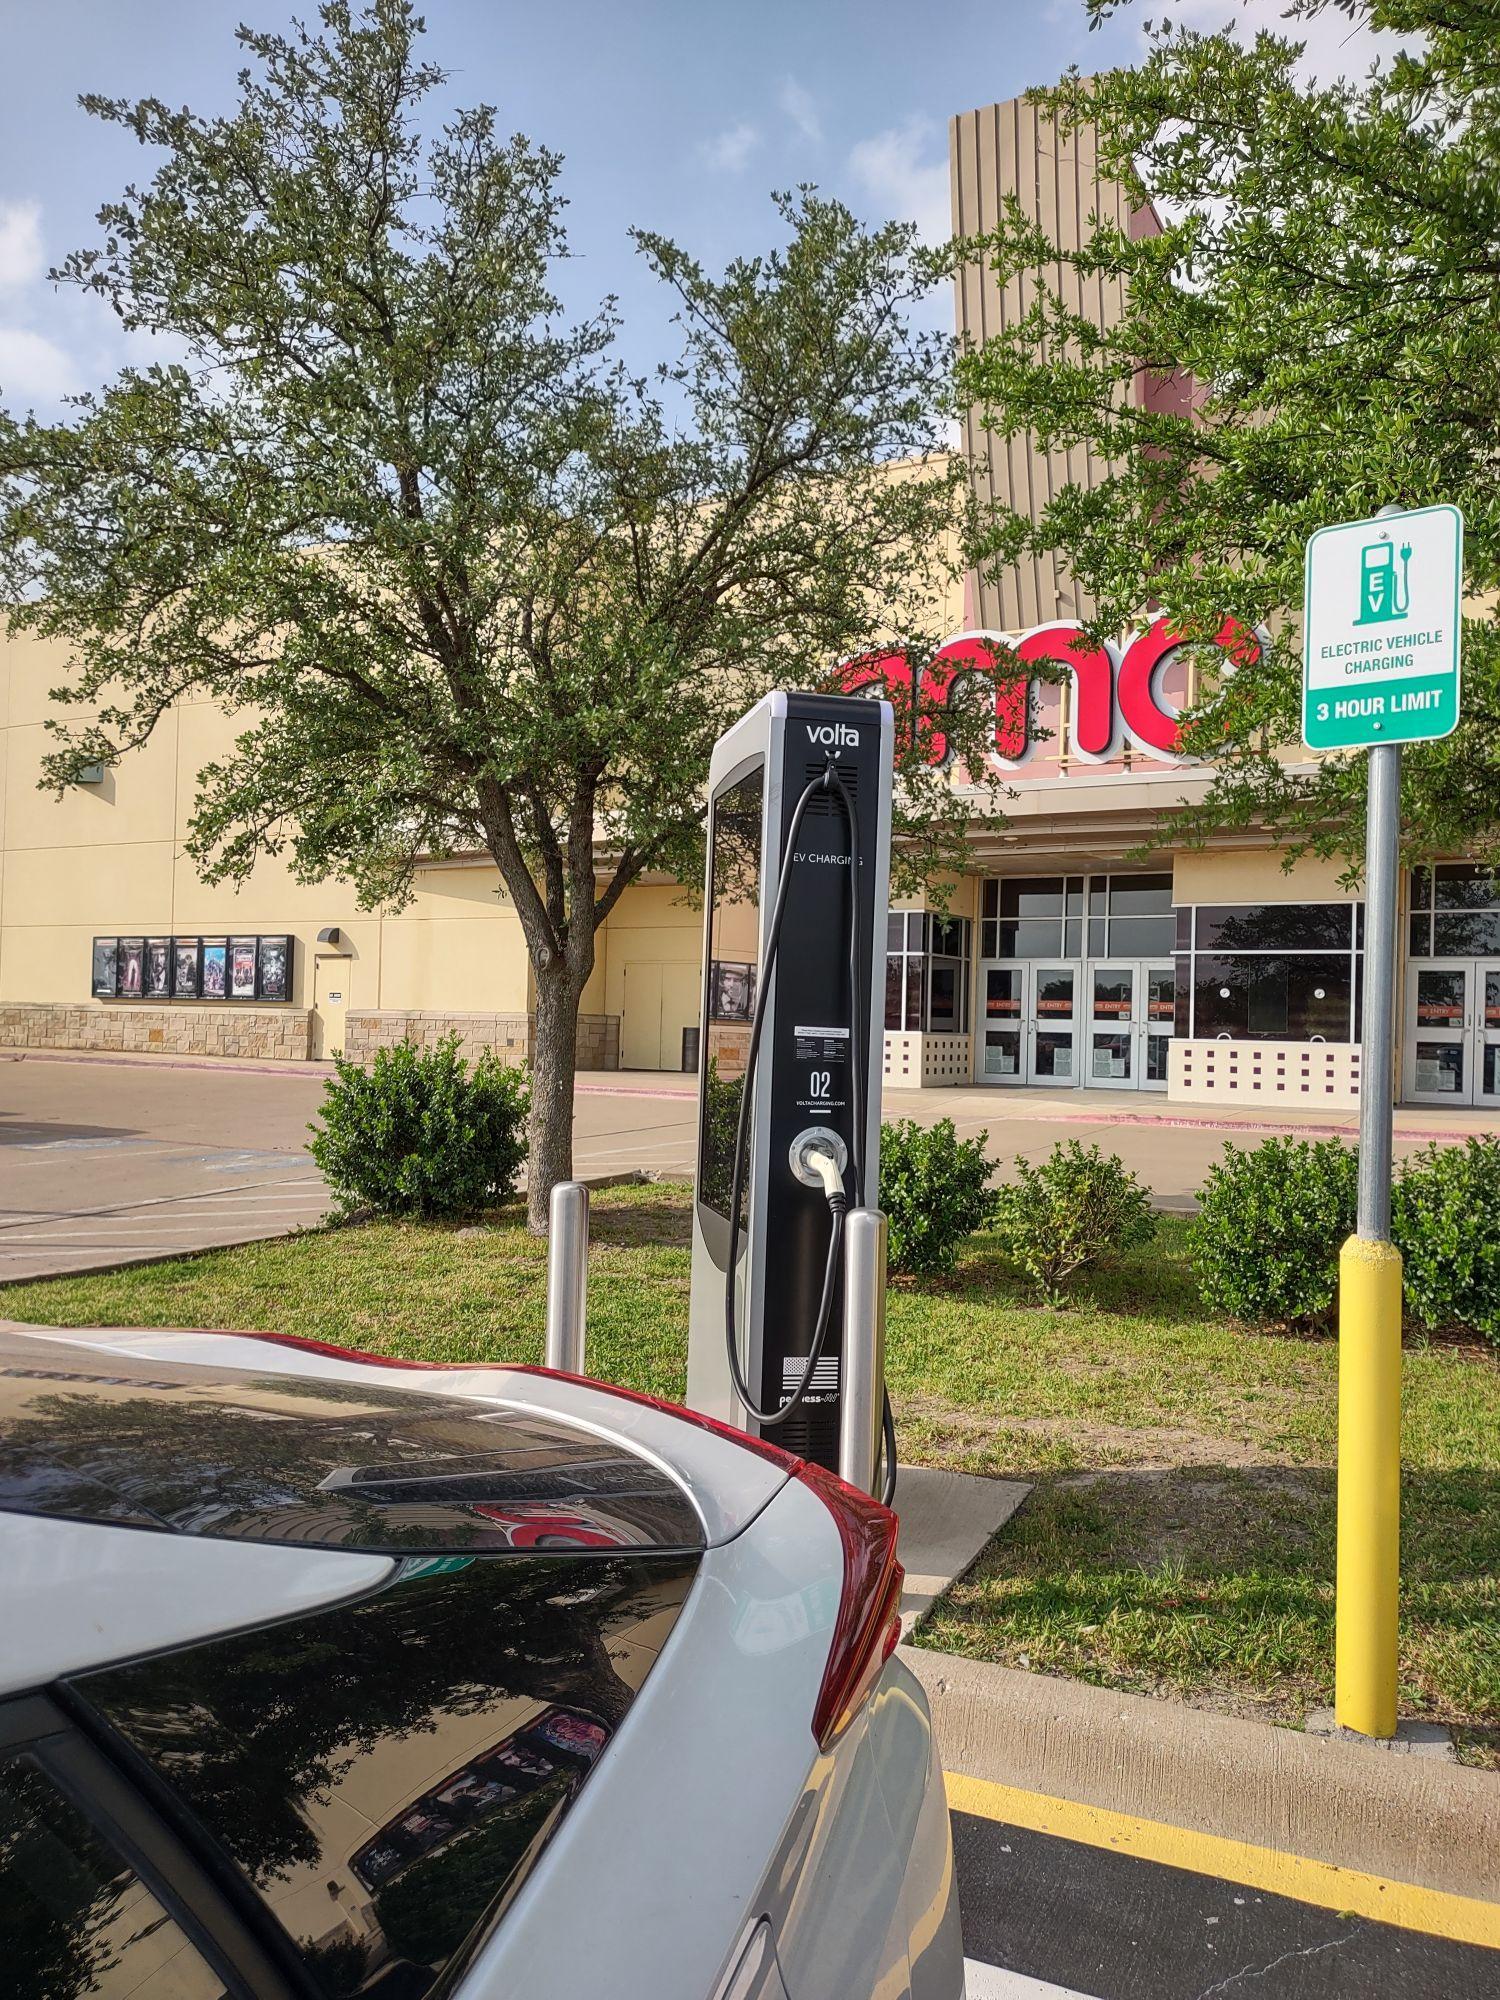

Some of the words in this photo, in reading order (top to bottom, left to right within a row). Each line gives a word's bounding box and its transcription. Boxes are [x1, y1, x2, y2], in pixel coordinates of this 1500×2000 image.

[1321, 638, 1383, 659] ELECTRIC
[1387, 629, 1443, 650] VEHICLE
[1344, 653, 1414, 675] CHARGING
[1316, 703, 1329, 721] 3
[1335, 697, 1385, 719] HOUR
[1391, 689, 1443, 713] LIMIT
[806, 723, 860, 747] volta
[793, 852, 806, 862] EV
[810, 1071, 831, 1098] 02
